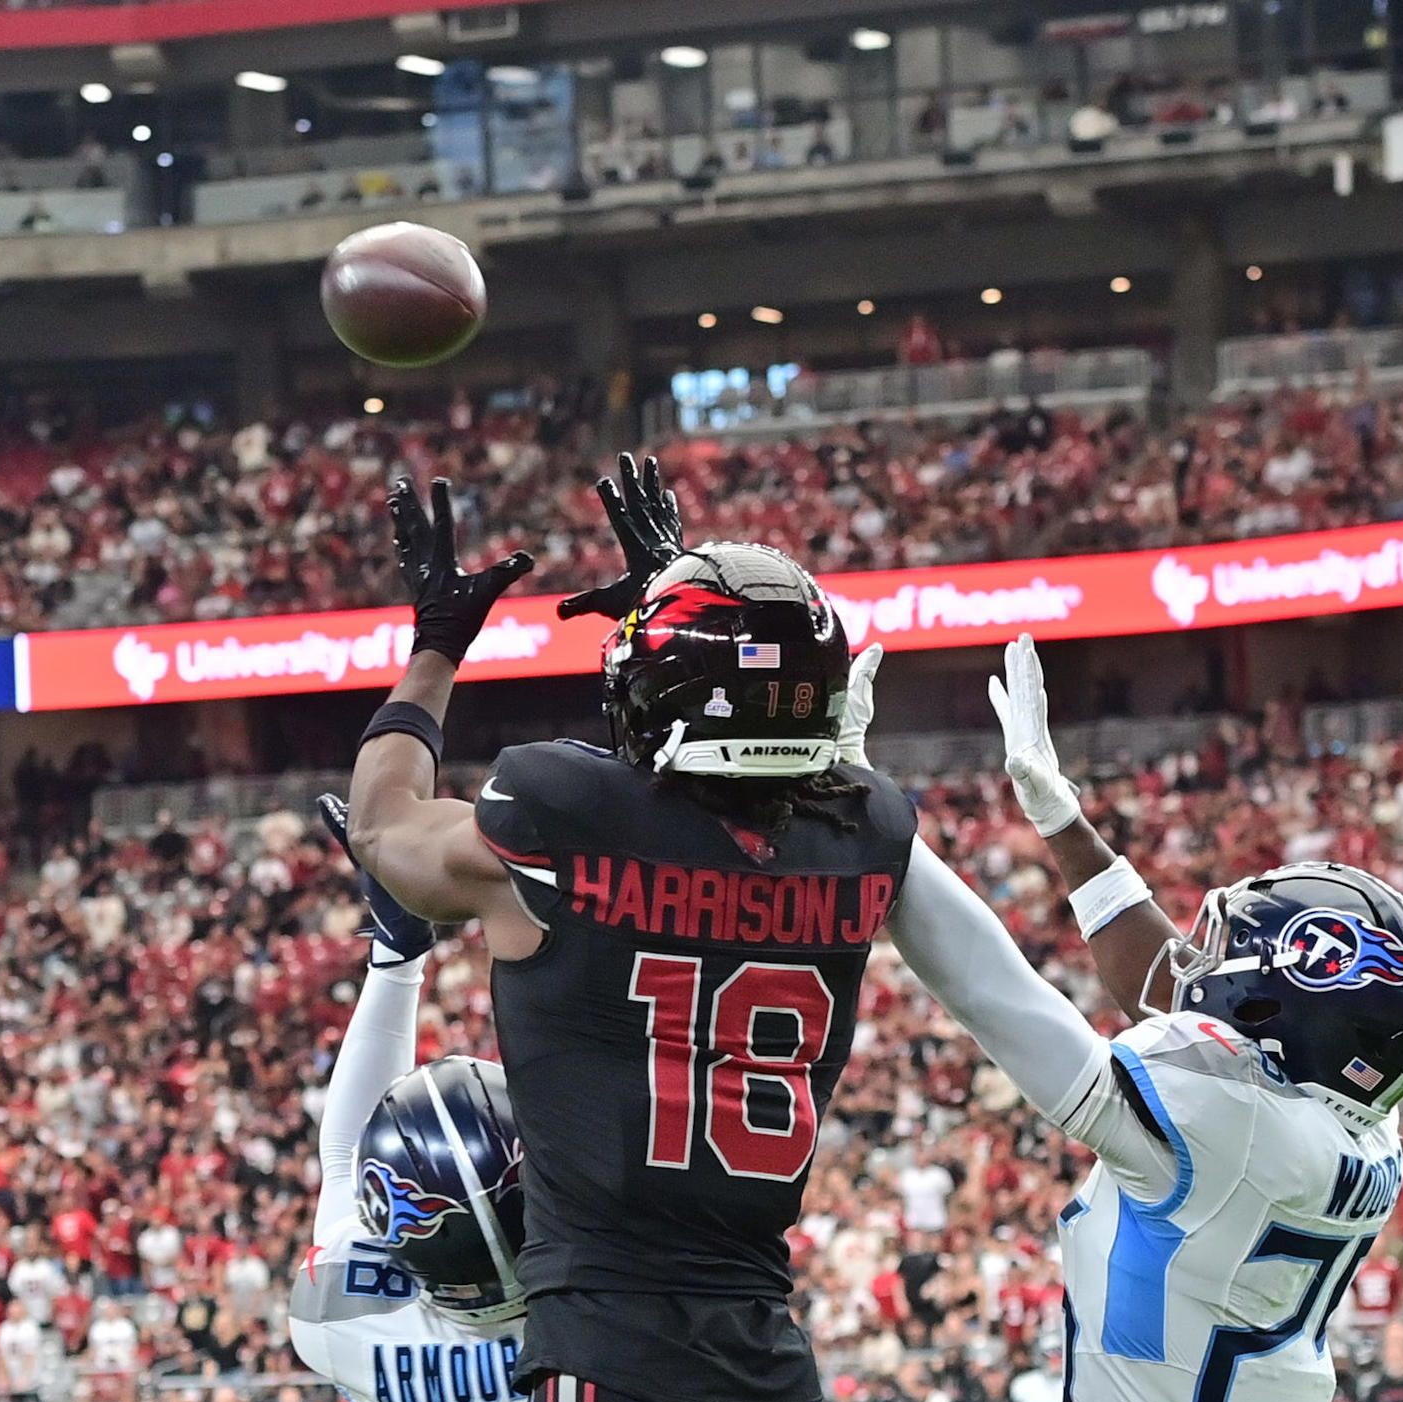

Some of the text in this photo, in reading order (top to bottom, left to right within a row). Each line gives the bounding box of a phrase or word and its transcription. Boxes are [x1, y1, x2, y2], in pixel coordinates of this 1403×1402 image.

[1213, 549, 1362, 606] University
[1363, 538, 1398, 588] of
[872, 585, 917, 634] of
[918, 577, 1080, 629] Phoenix
[176, 630, 350, 683] University
[351, 623, 393, 671] of
[767, 681, 814, 719] 18
[740, 746, 811, 756] ARIZONA
[571, 855, 837, 944] HARRISON
[627, 951, 834, 1183] 18
[1323, 1096, 1373, 1127] TENNE
[1325, 1150, 1402, 1219] WOOD
